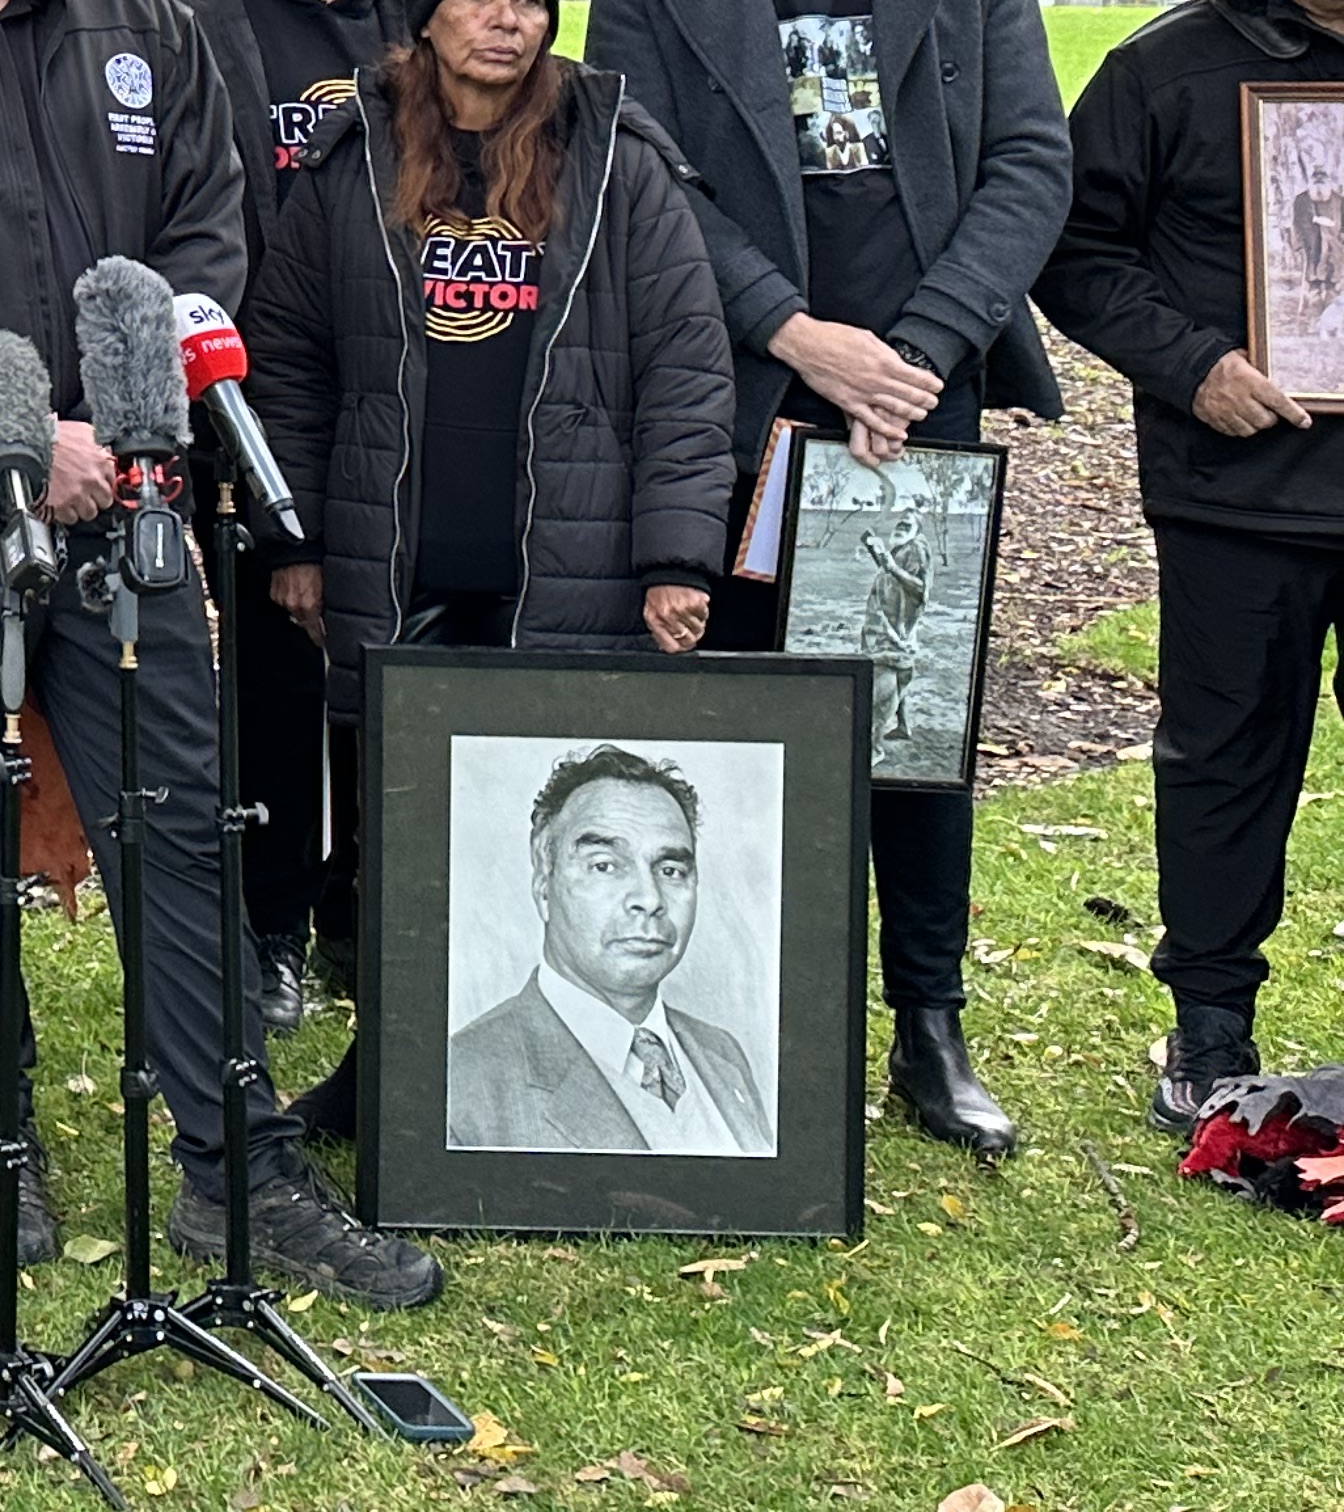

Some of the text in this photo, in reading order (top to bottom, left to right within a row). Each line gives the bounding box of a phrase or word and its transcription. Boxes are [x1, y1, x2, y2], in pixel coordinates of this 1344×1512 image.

[420, 237, 546, 282] EAT
[189, 305, 224, 325] sky
[201, 336, 243, 353] news
